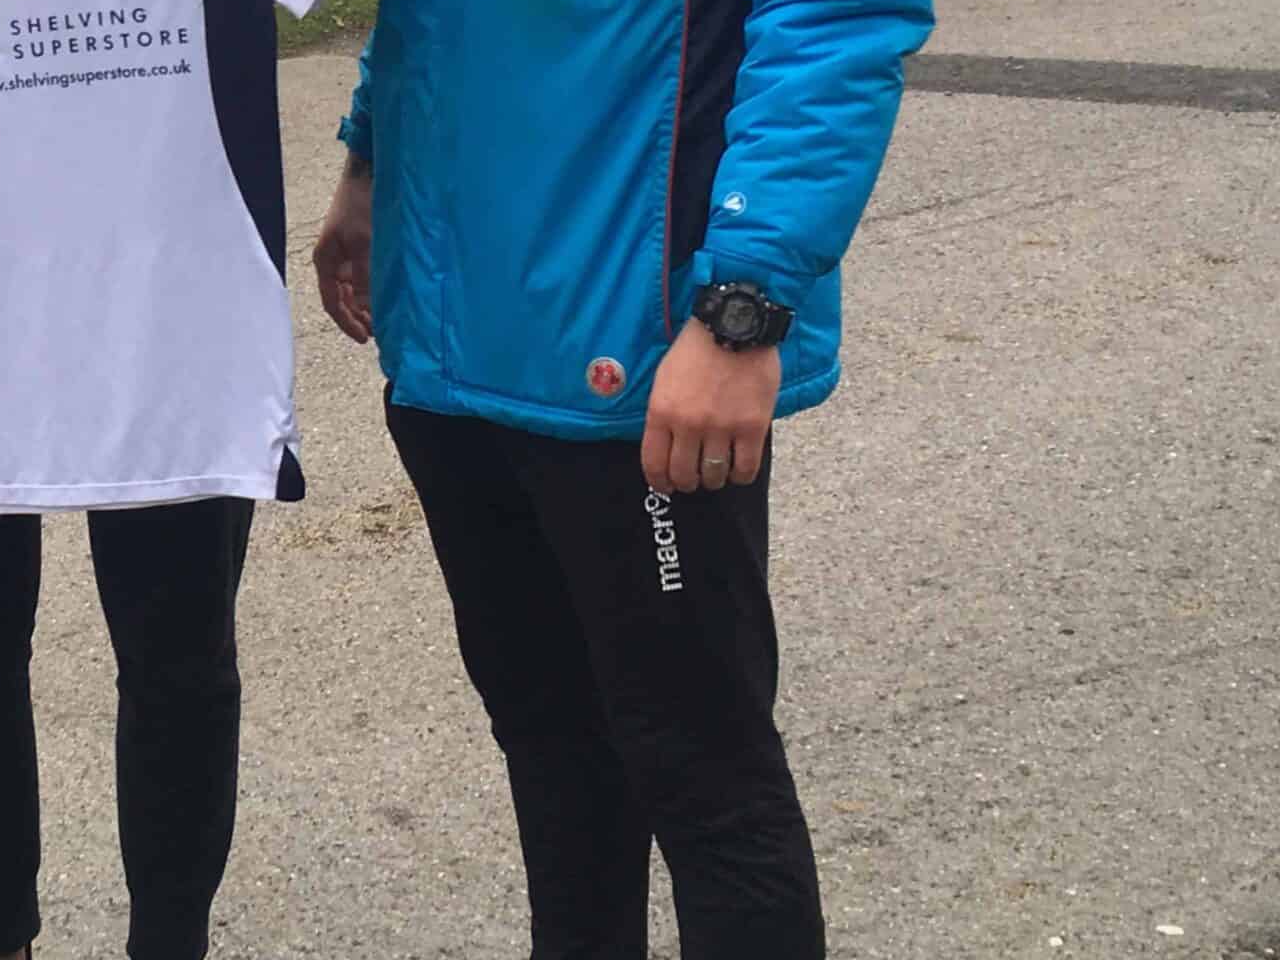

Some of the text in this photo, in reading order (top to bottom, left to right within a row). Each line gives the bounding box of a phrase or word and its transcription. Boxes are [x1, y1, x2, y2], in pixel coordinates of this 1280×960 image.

[10, 7, 148, 36] SHELVING
[13, 27, 190, 60] SUPERSTORE
[644, 485, 684, 592] macro
